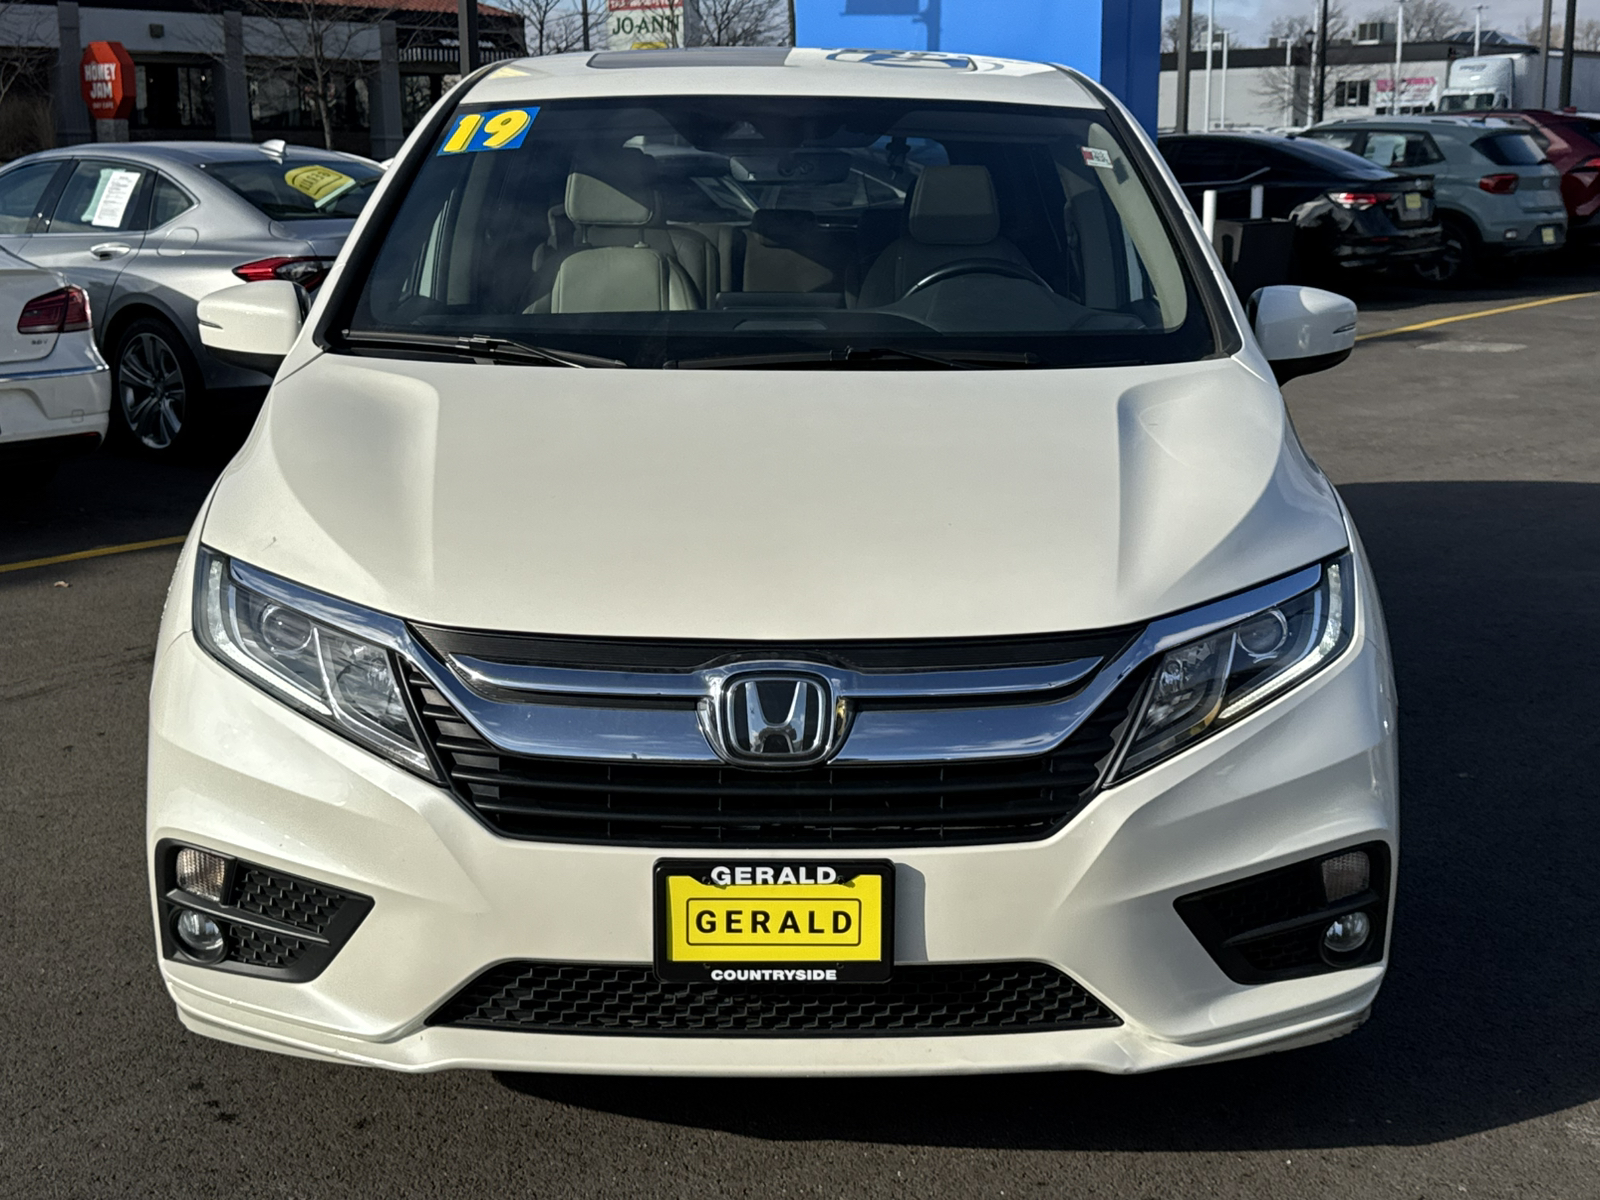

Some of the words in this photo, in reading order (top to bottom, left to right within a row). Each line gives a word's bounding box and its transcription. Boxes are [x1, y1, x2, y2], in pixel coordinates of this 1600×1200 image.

[84, 63, 116, 81] HONEY
[90, 82, 113, 99] JAM
[443, 109, 531, 152] 19
[710, 866, 837, 885] GERALD
[695, 910, 852, 934] GERALD
[710, 969, 837, 981] COUNTRYSIDE
